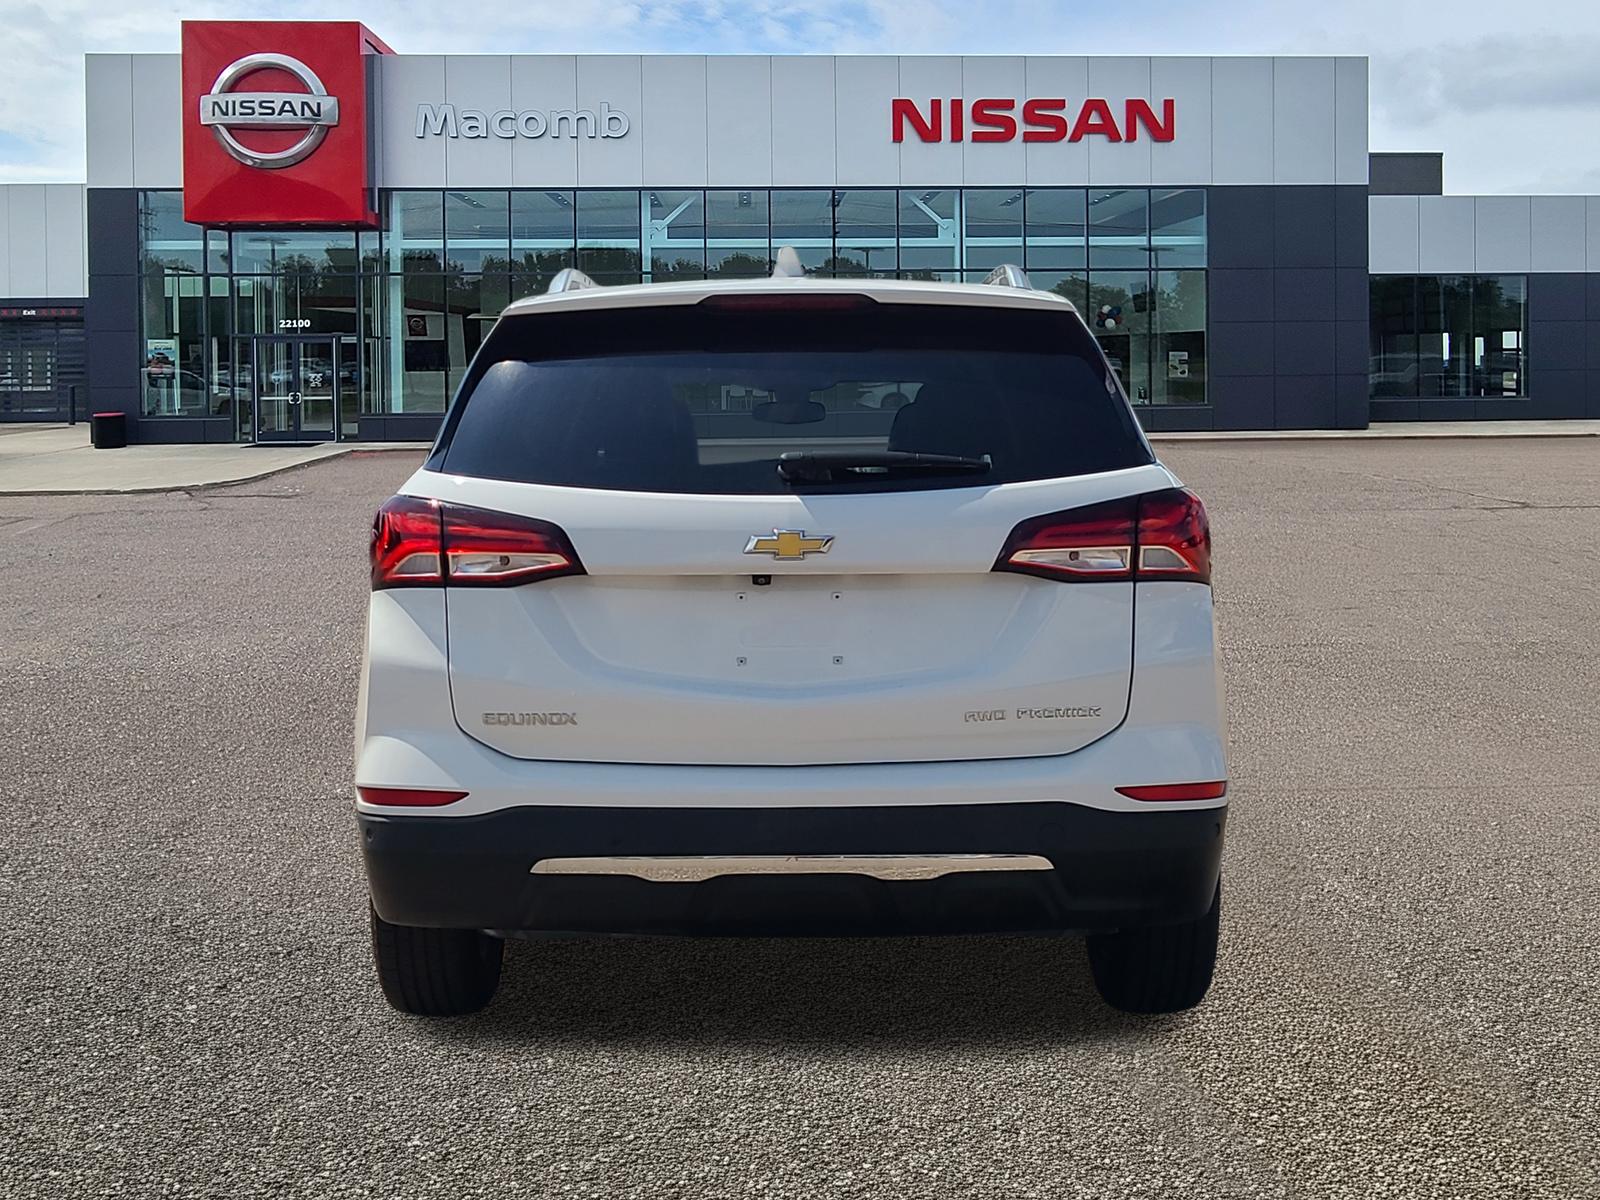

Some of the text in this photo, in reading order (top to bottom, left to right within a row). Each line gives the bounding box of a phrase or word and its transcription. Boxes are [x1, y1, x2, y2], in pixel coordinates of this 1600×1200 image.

[212, 100, 322, 117] NISSAN
[415, 101, 630, 139] Macomb
[892, 98, 1175, 143] NISSAN
[279, 319, 311, 328] 22100
[481, 712, 578, 726] EQUINOX
[964, 706, 1102, 722] AWD PREMIER
